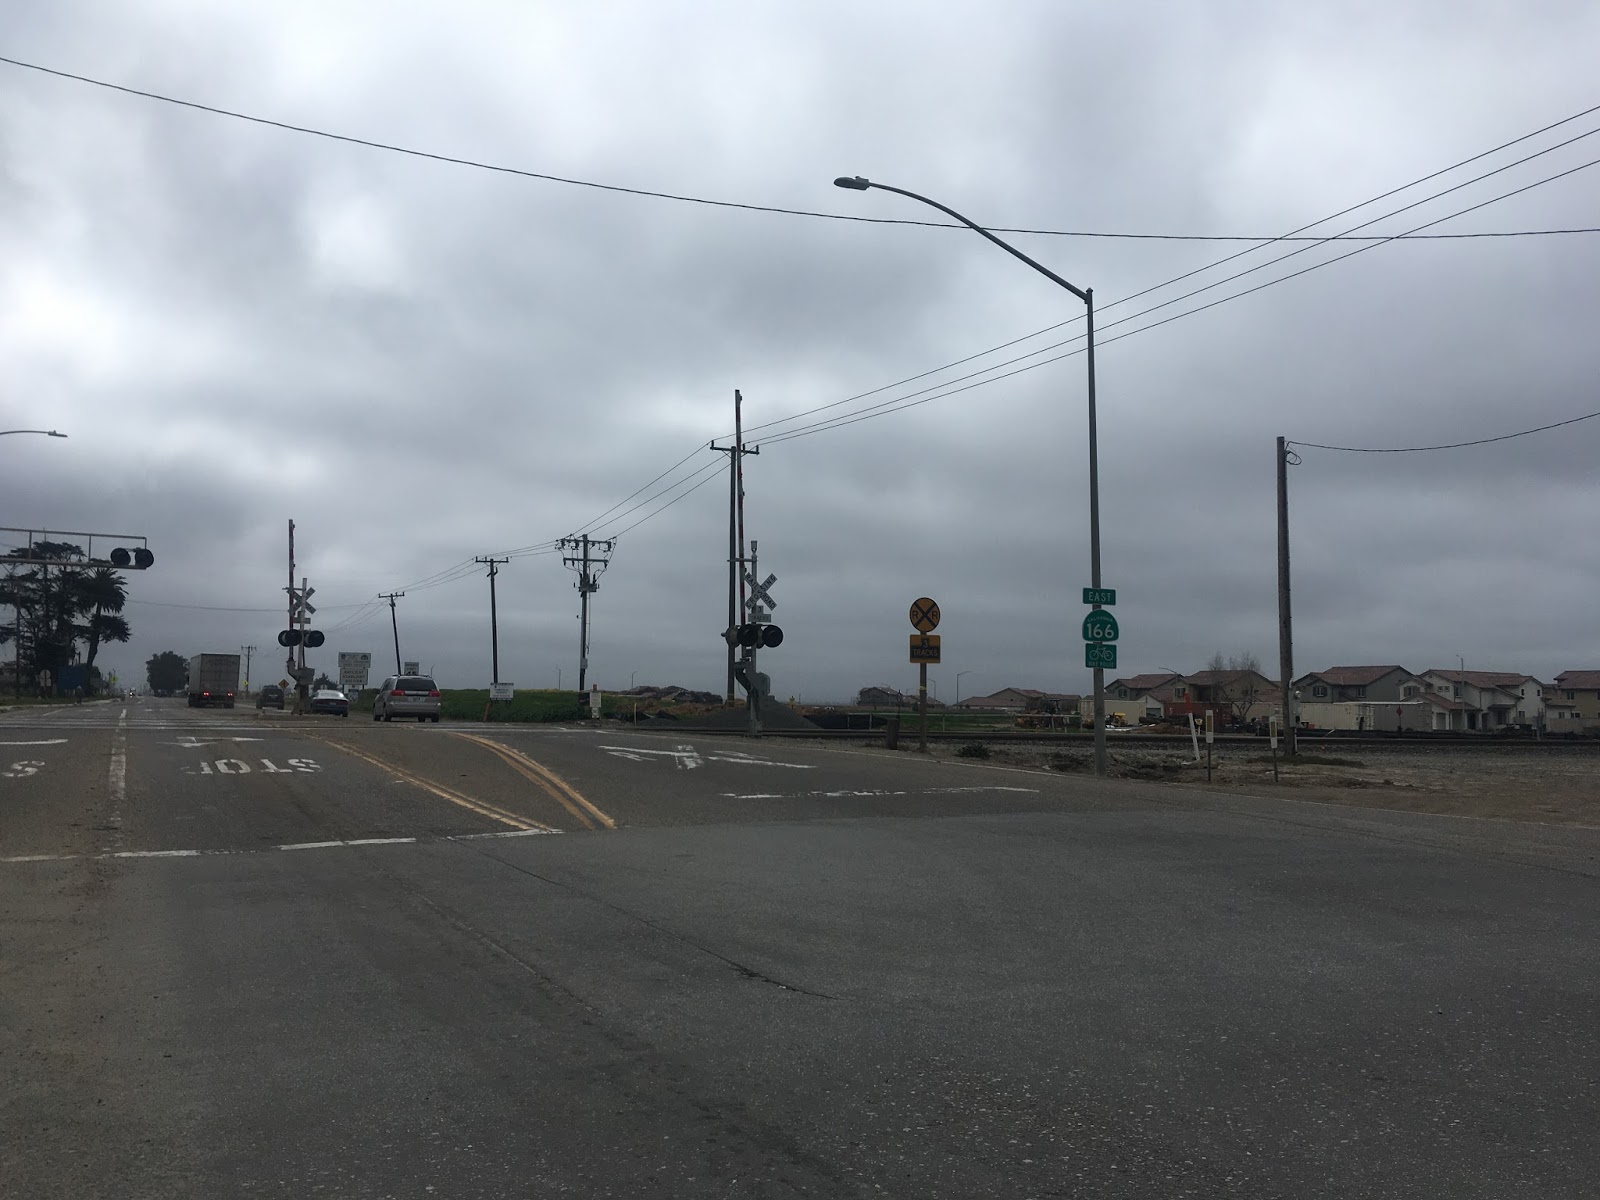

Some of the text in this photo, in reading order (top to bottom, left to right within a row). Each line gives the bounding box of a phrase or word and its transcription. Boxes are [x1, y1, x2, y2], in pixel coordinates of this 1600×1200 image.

[1088, 591, 1112, 602] EAST
[1087, 623, 1115, 639] 166
[923, 639, 928, 648] 3
[913, 649, 938, 657] TRACKS
